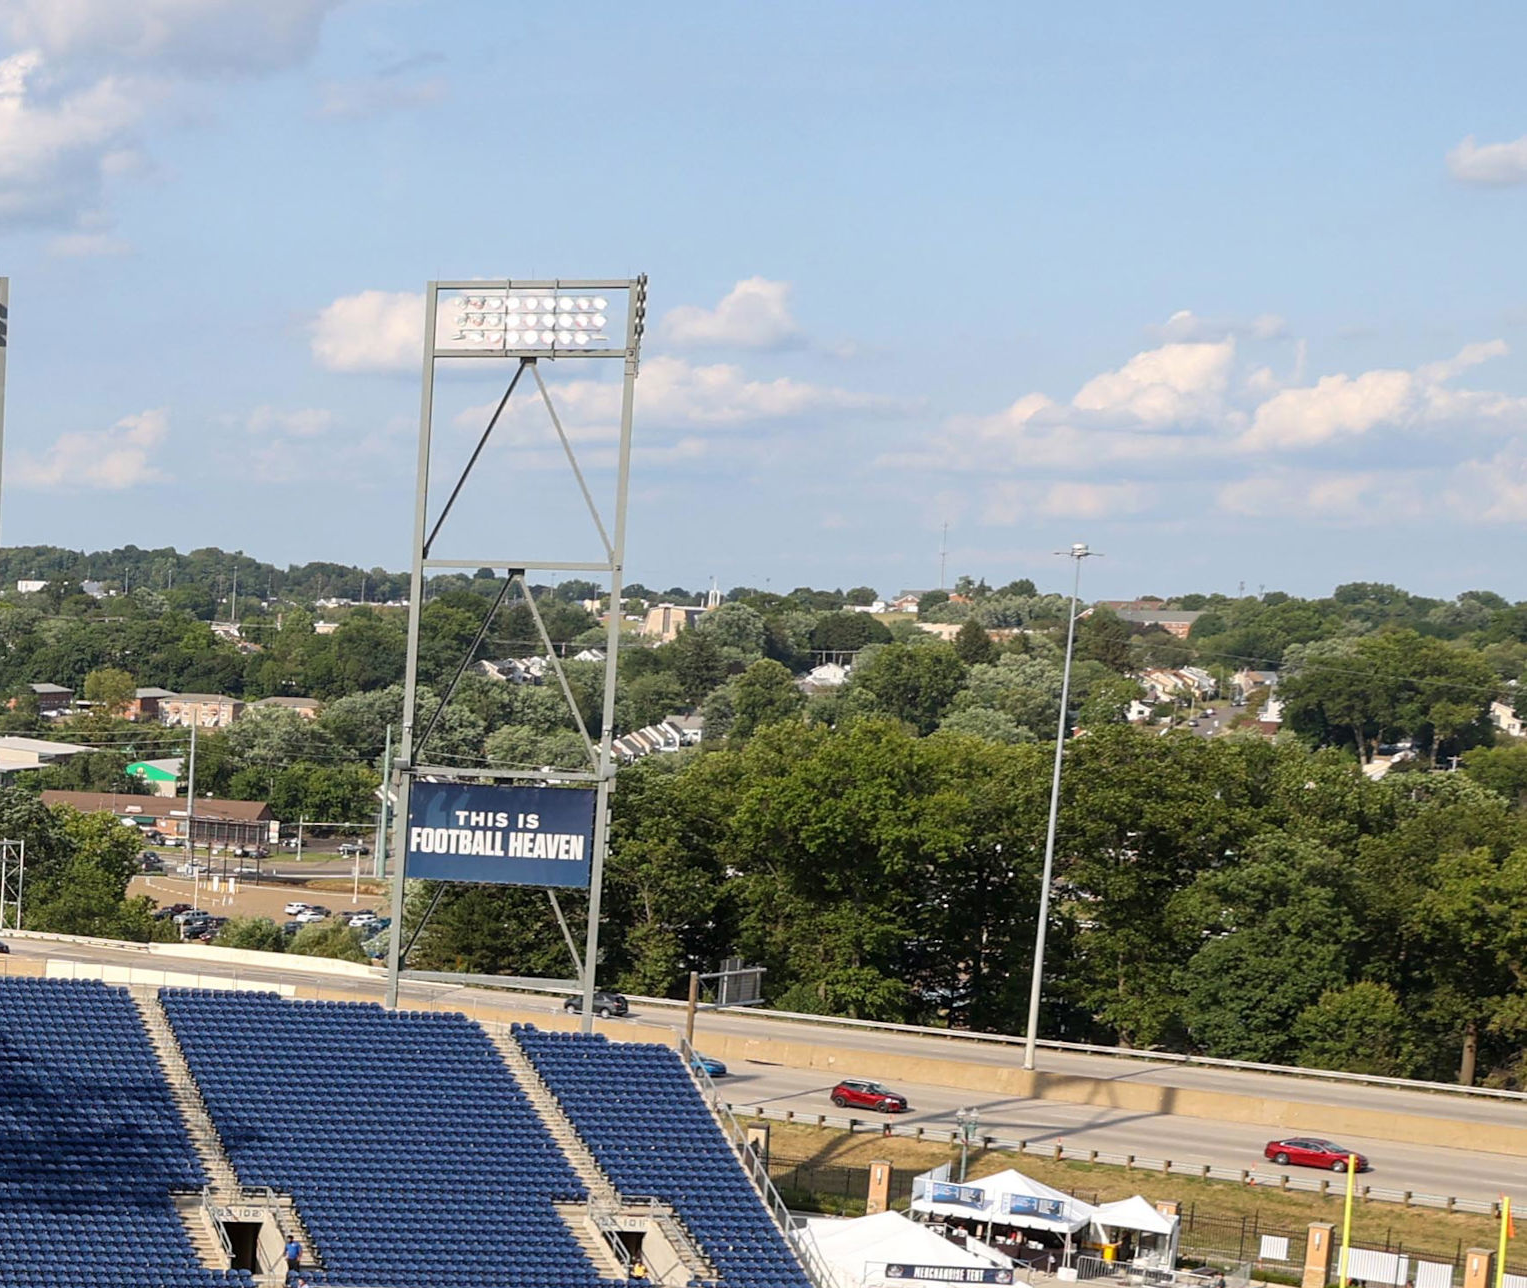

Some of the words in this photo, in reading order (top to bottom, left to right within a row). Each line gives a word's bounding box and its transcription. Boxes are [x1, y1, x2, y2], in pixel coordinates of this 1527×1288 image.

[455, 811, 508, 828] THIS
[518, 813, 540, 829] IS
[410, 827, 504, 857] FOOTBALL
[508, 831, 584, 861] HEAVEN
[913, 1267, 965, 1281] MERCHANDISE
[966, 1268, 984, 1281] TENT
